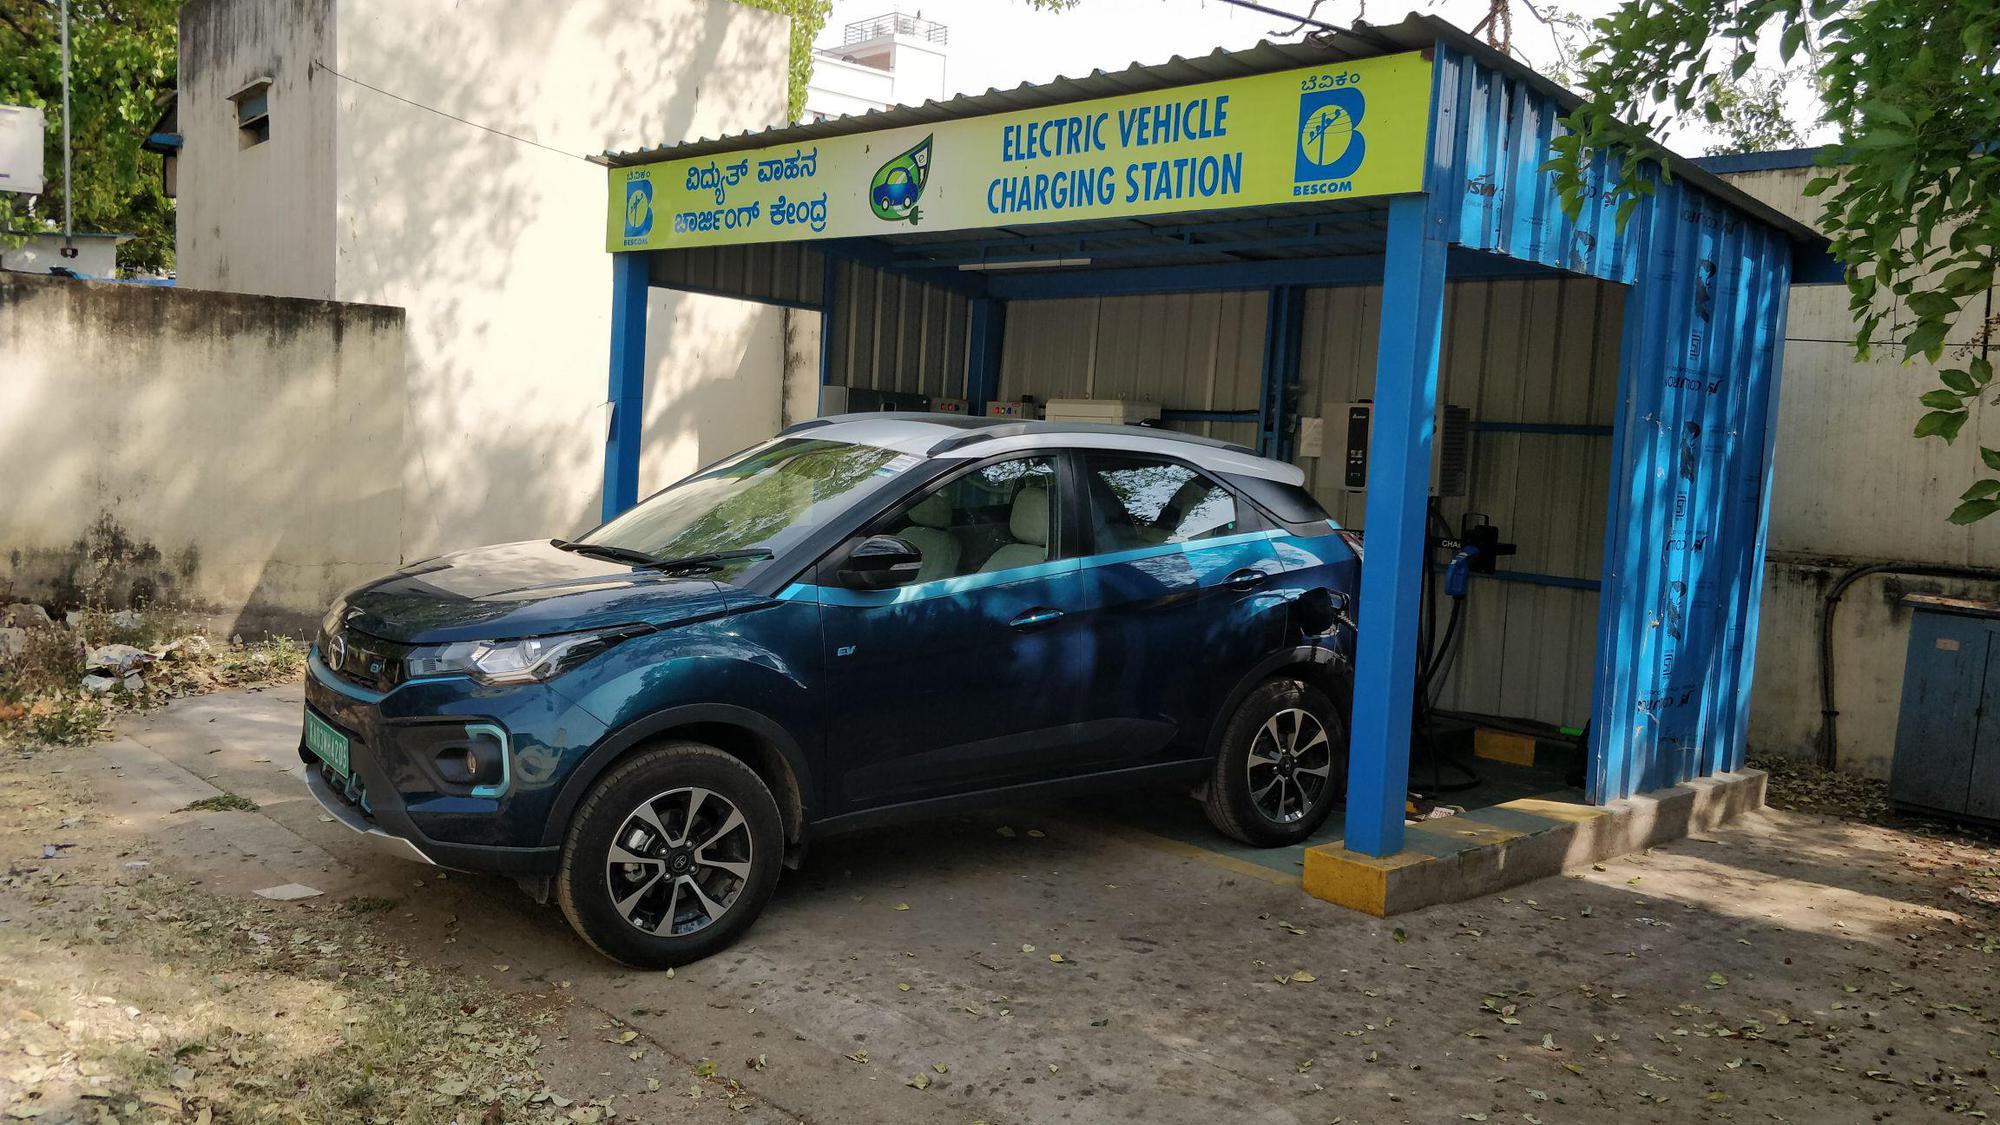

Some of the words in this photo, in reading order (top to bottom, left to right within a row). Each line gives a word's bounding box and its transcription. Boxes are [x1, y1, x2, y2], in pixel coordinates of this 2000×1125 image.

[1301, 71, 1361, 91] ಬೆವಿಕಂ
[1002, 112, 1110, 163] ELECTRIC
[1118, 95, 1230, 149] VEHICLE
[685, 160, 749, 206] ವಿದ್ಯುತ್
[757, 147, 818, 183] ವಾಹನ
[987, 166, 1116, 215] CHARGING
[1125, 152, 1243, 203] STATION
[1292, 181, 1353, 197] BESCOM
[674, 200, 760, 234] ಚಾರ್ಜಿಂಗ್
[769, 191, 828, 233] ಕೇಂದ್ರ
[623, 239, 648, 247] BESCOM
